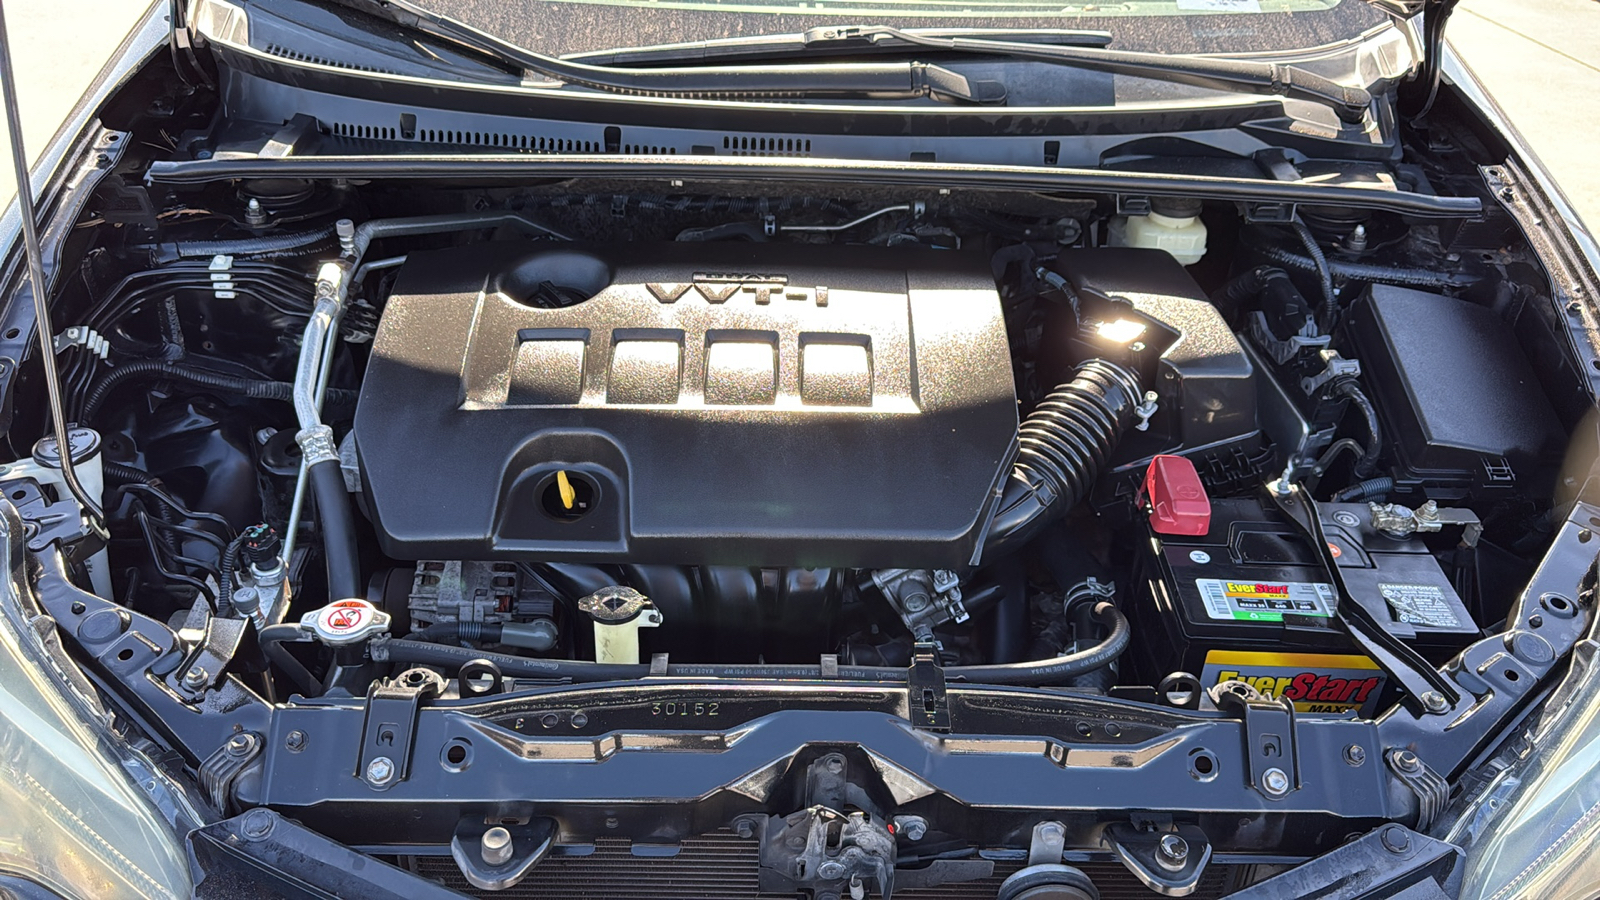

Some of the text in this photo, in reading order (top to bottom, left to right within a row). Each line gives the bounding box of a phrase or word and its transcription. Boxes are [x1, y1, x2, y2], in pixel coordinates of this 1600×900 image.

[1226, 582, 1288, 594] EverStart
[1030, 667, 1044, 675] USA
[1052, 664, 1070, 672] MADE
[651, 702, 720, 716] 30152
